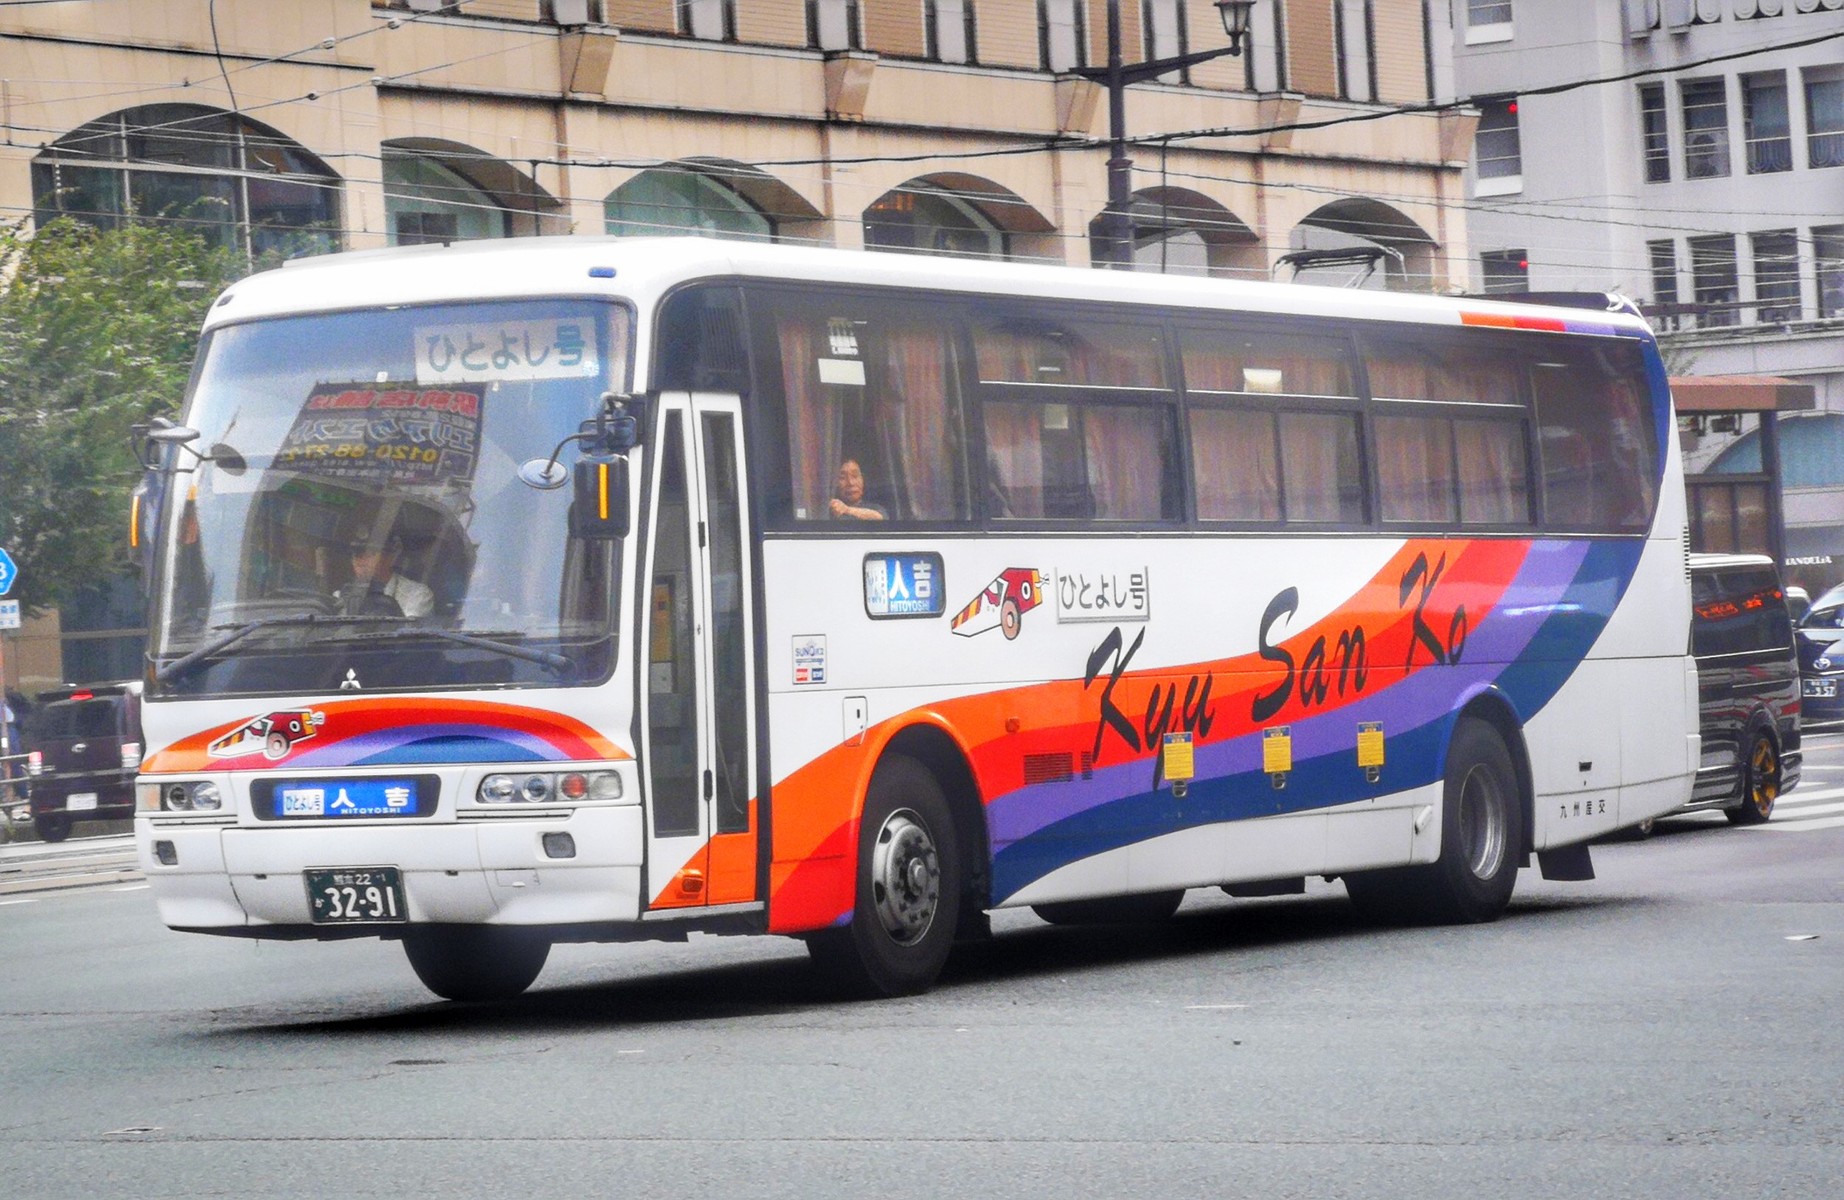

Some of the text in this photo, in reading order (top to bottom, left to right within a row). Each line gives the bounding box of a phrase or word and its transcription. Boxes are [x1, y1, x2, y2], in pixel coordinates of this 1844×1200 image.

[426, 325, 586, 373] ひとよし号
[889, 560, 932, 599] 人吉
[1059, 573, 1146, 610] ひとよし号
[890, 600, 930, 612] HITOYOSHI
[1084, 551, 1467, 791] Kyu San Ko
[331, 787, 410, 808] 人吉
[324, 886, 397, 918] 32-91
